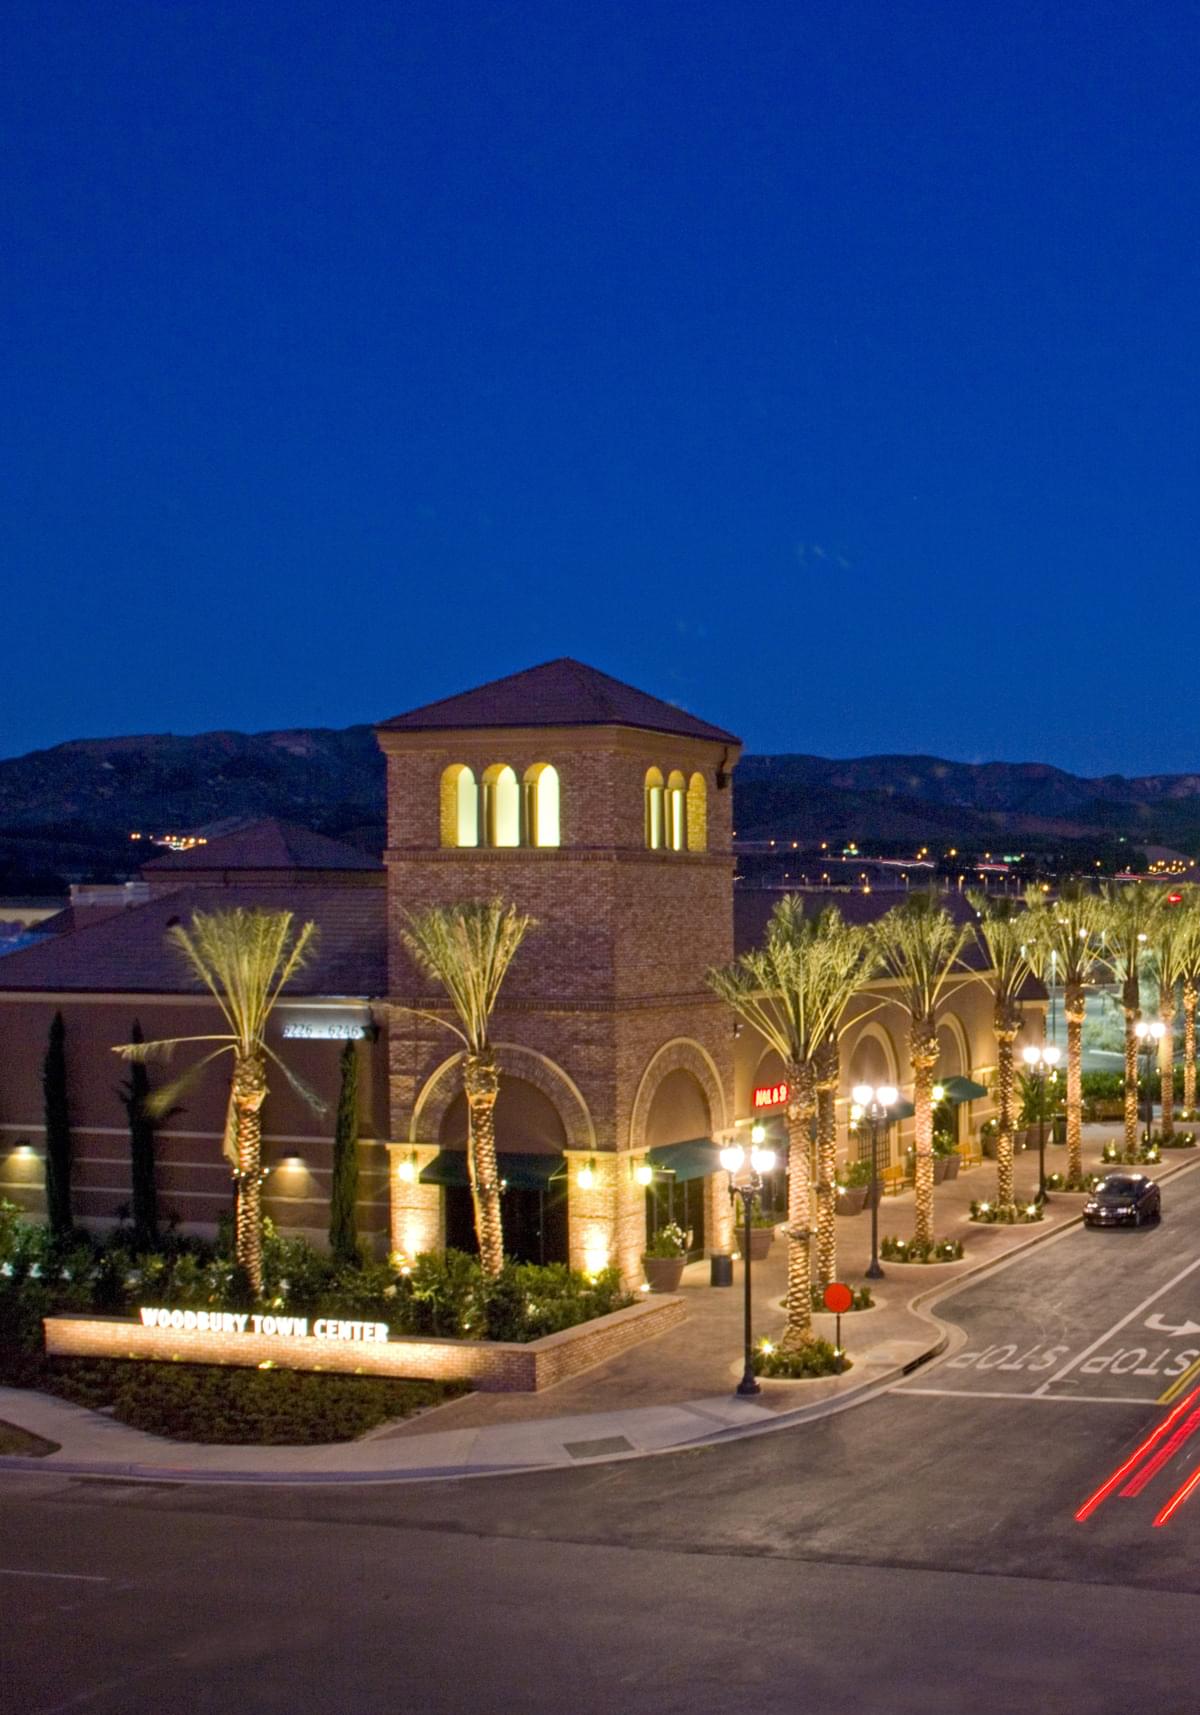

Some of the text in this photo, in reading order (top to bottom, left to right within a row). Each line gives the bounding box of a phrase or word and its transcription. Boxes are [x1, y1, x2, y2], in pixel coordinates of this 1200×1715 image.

[140, 1307, 389, 1343] WOODBURY TOWN CENTER
[946, 1344, 1069, 1371] STOP
[1080, 1348, 1200, 1376] STOP
